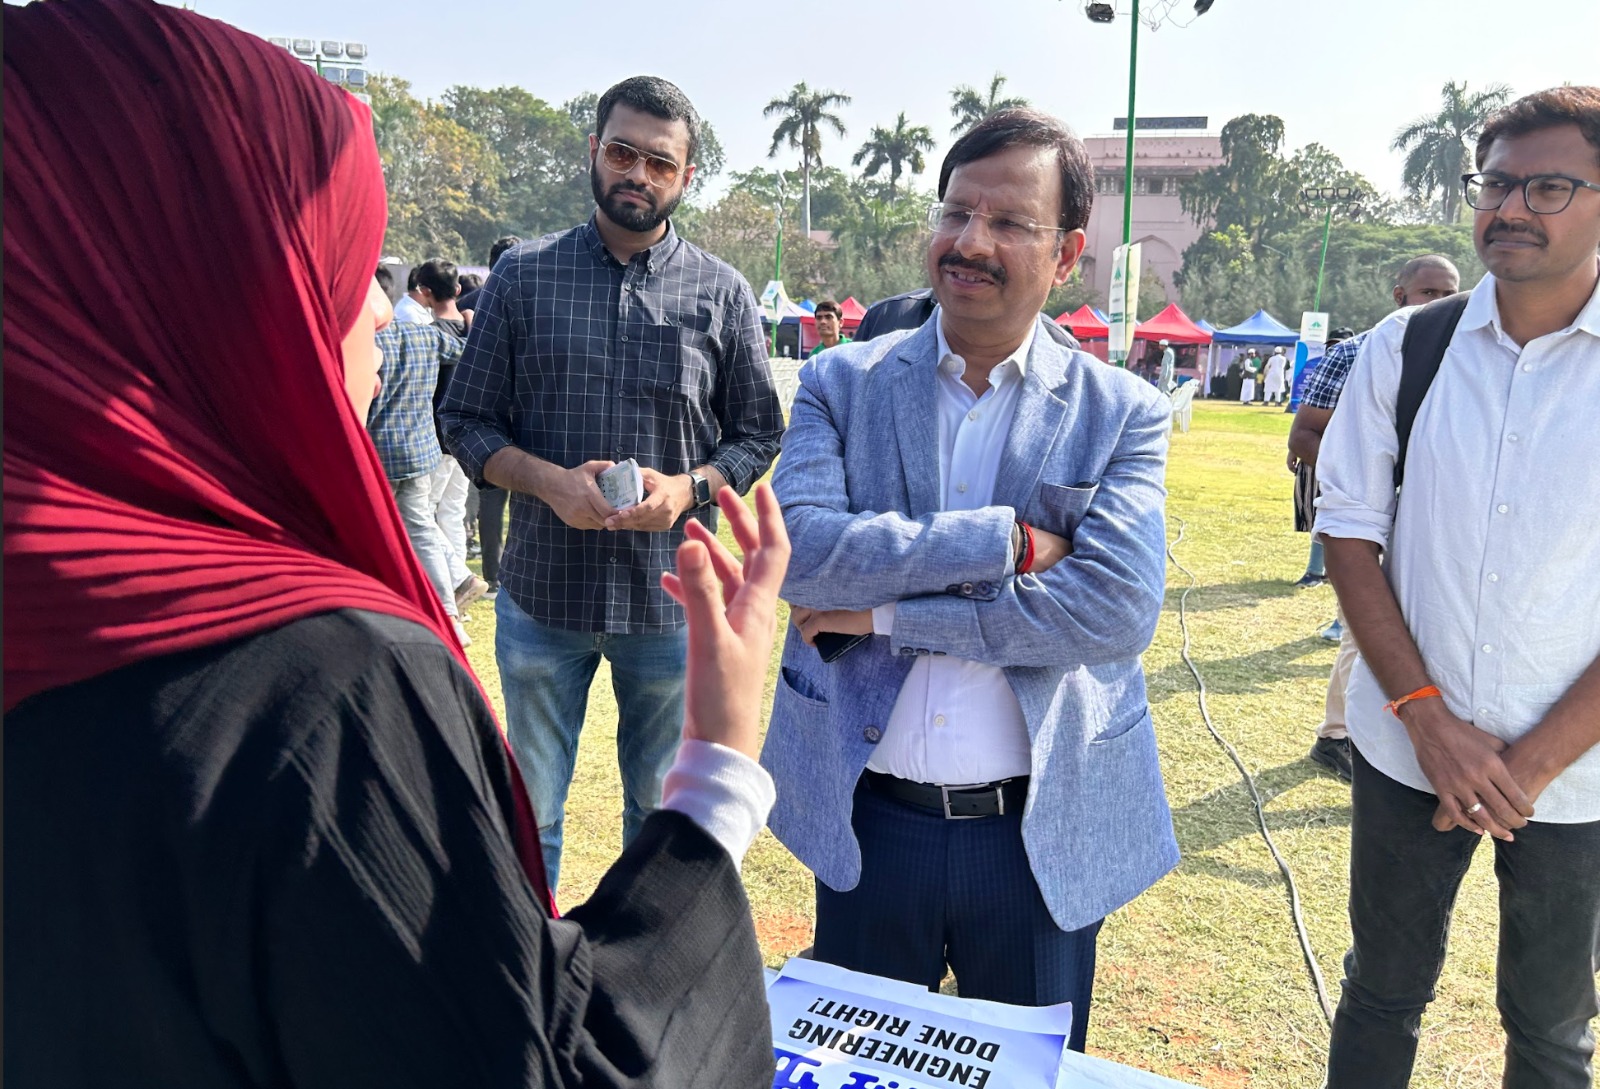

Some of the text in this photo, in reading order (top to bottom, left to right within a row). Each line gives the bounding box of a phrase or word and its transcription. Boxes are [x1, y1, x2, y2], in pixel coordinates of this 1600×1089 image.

[788, 1018, 991, 1089] ENGINEERING
[807, 997, 1000, 1062] DONE RIGHT!
